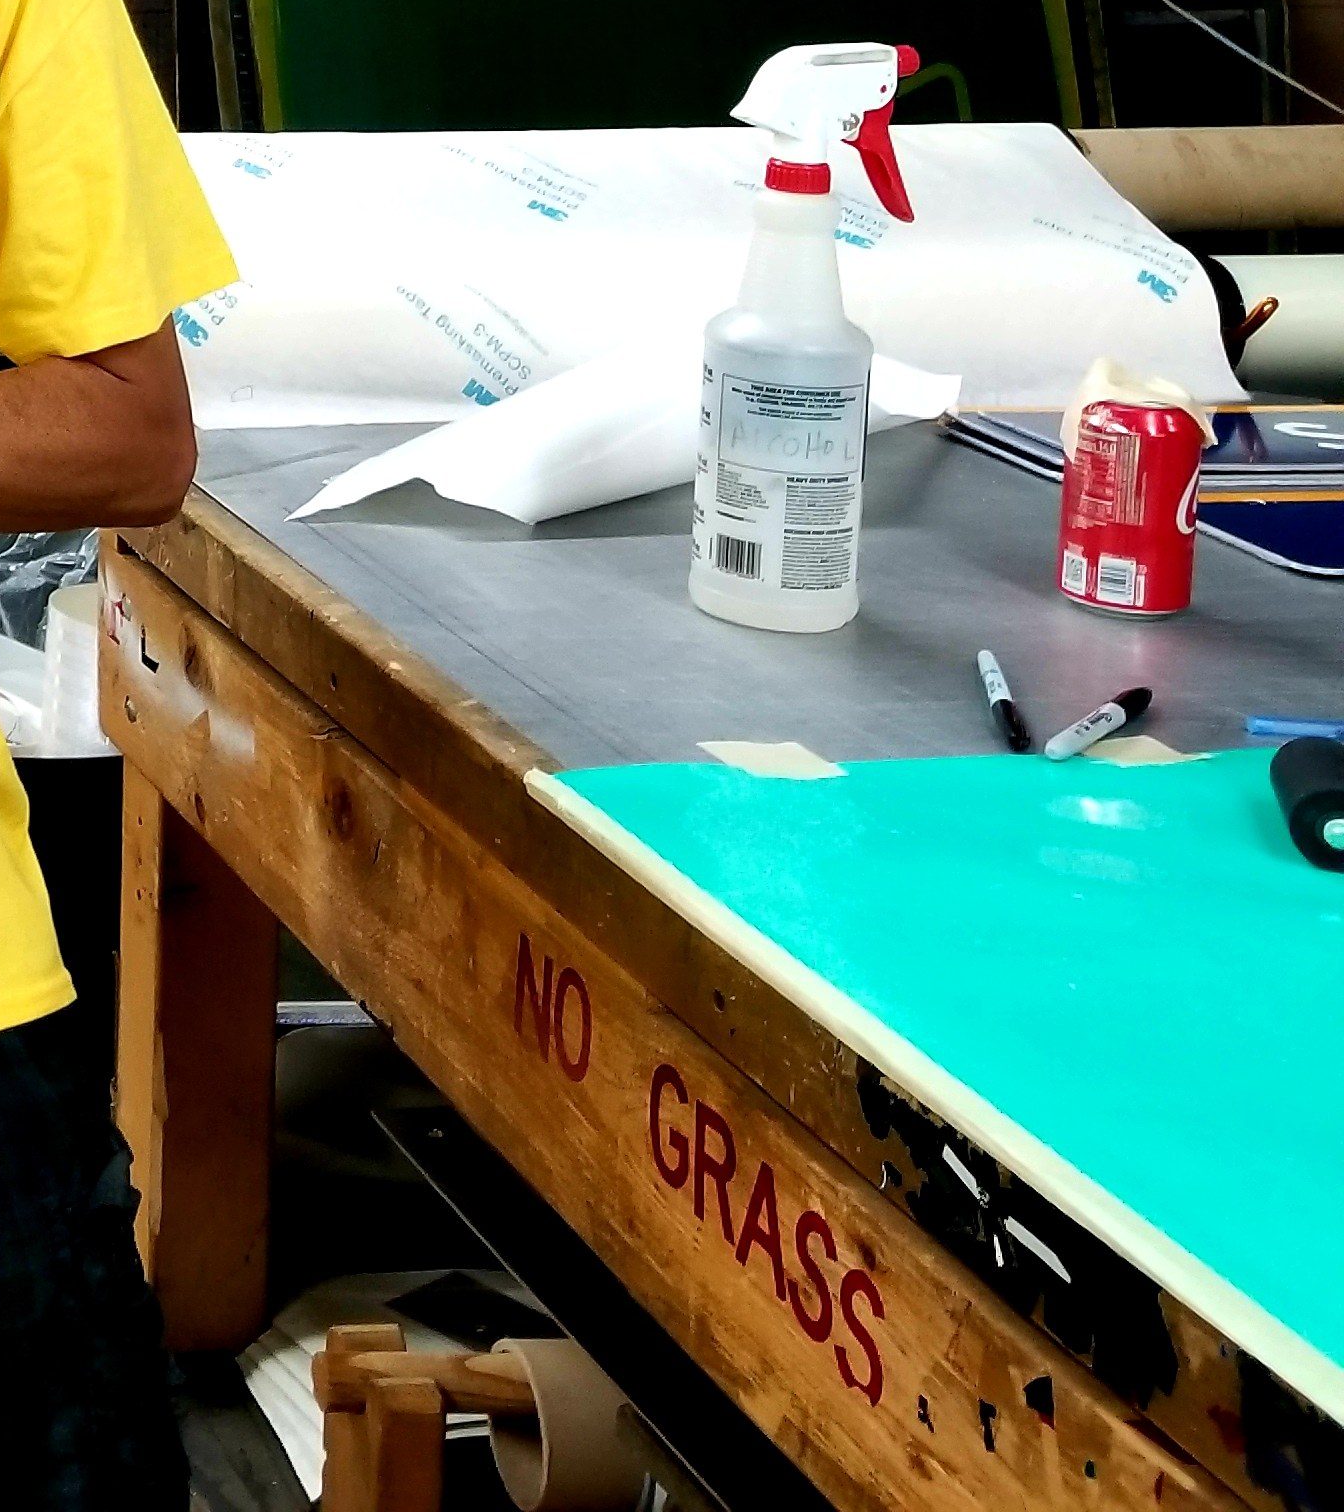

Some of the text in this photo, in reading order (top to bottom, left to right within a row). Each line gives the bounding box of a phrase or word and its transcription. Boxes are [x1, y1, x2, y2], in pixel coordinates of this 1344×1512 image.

[1137, 270, 1177, 303] 3M
[436, 314, 519, 396] Premasking
[462, 378, 500, 406] M
[514, 933, 885, 1407] NO GRASS
